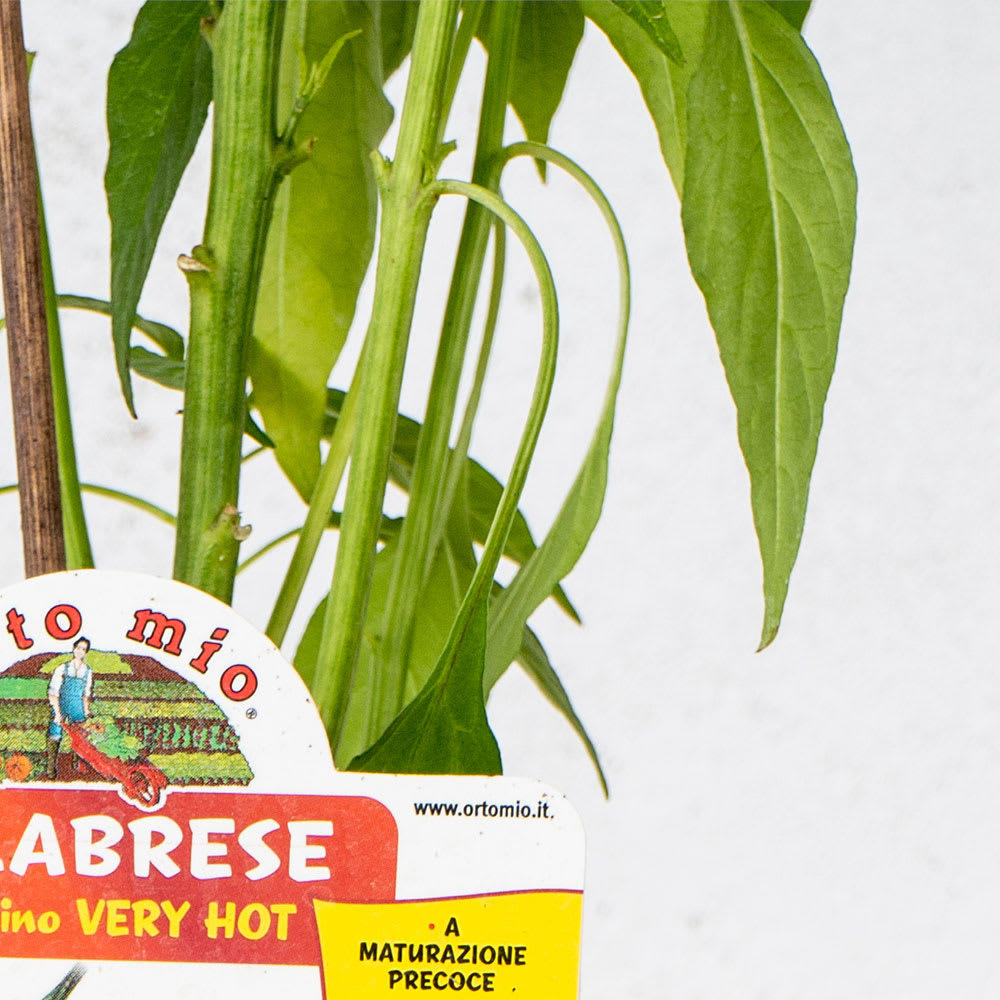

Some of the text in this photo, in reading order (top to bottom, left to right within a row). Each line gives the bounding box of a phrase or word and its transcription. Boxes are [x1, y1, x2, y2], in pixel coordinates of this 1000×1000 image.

[126, 608, 258, 702] mio
[75, 898, 191, 938] VERY
[204, 901, 298, 941] HOT
[444, 917, 460, 937] A
[359, 941, 527, 966] MATURAZIONE
[388, 969, 496, 992] PRECOCE
